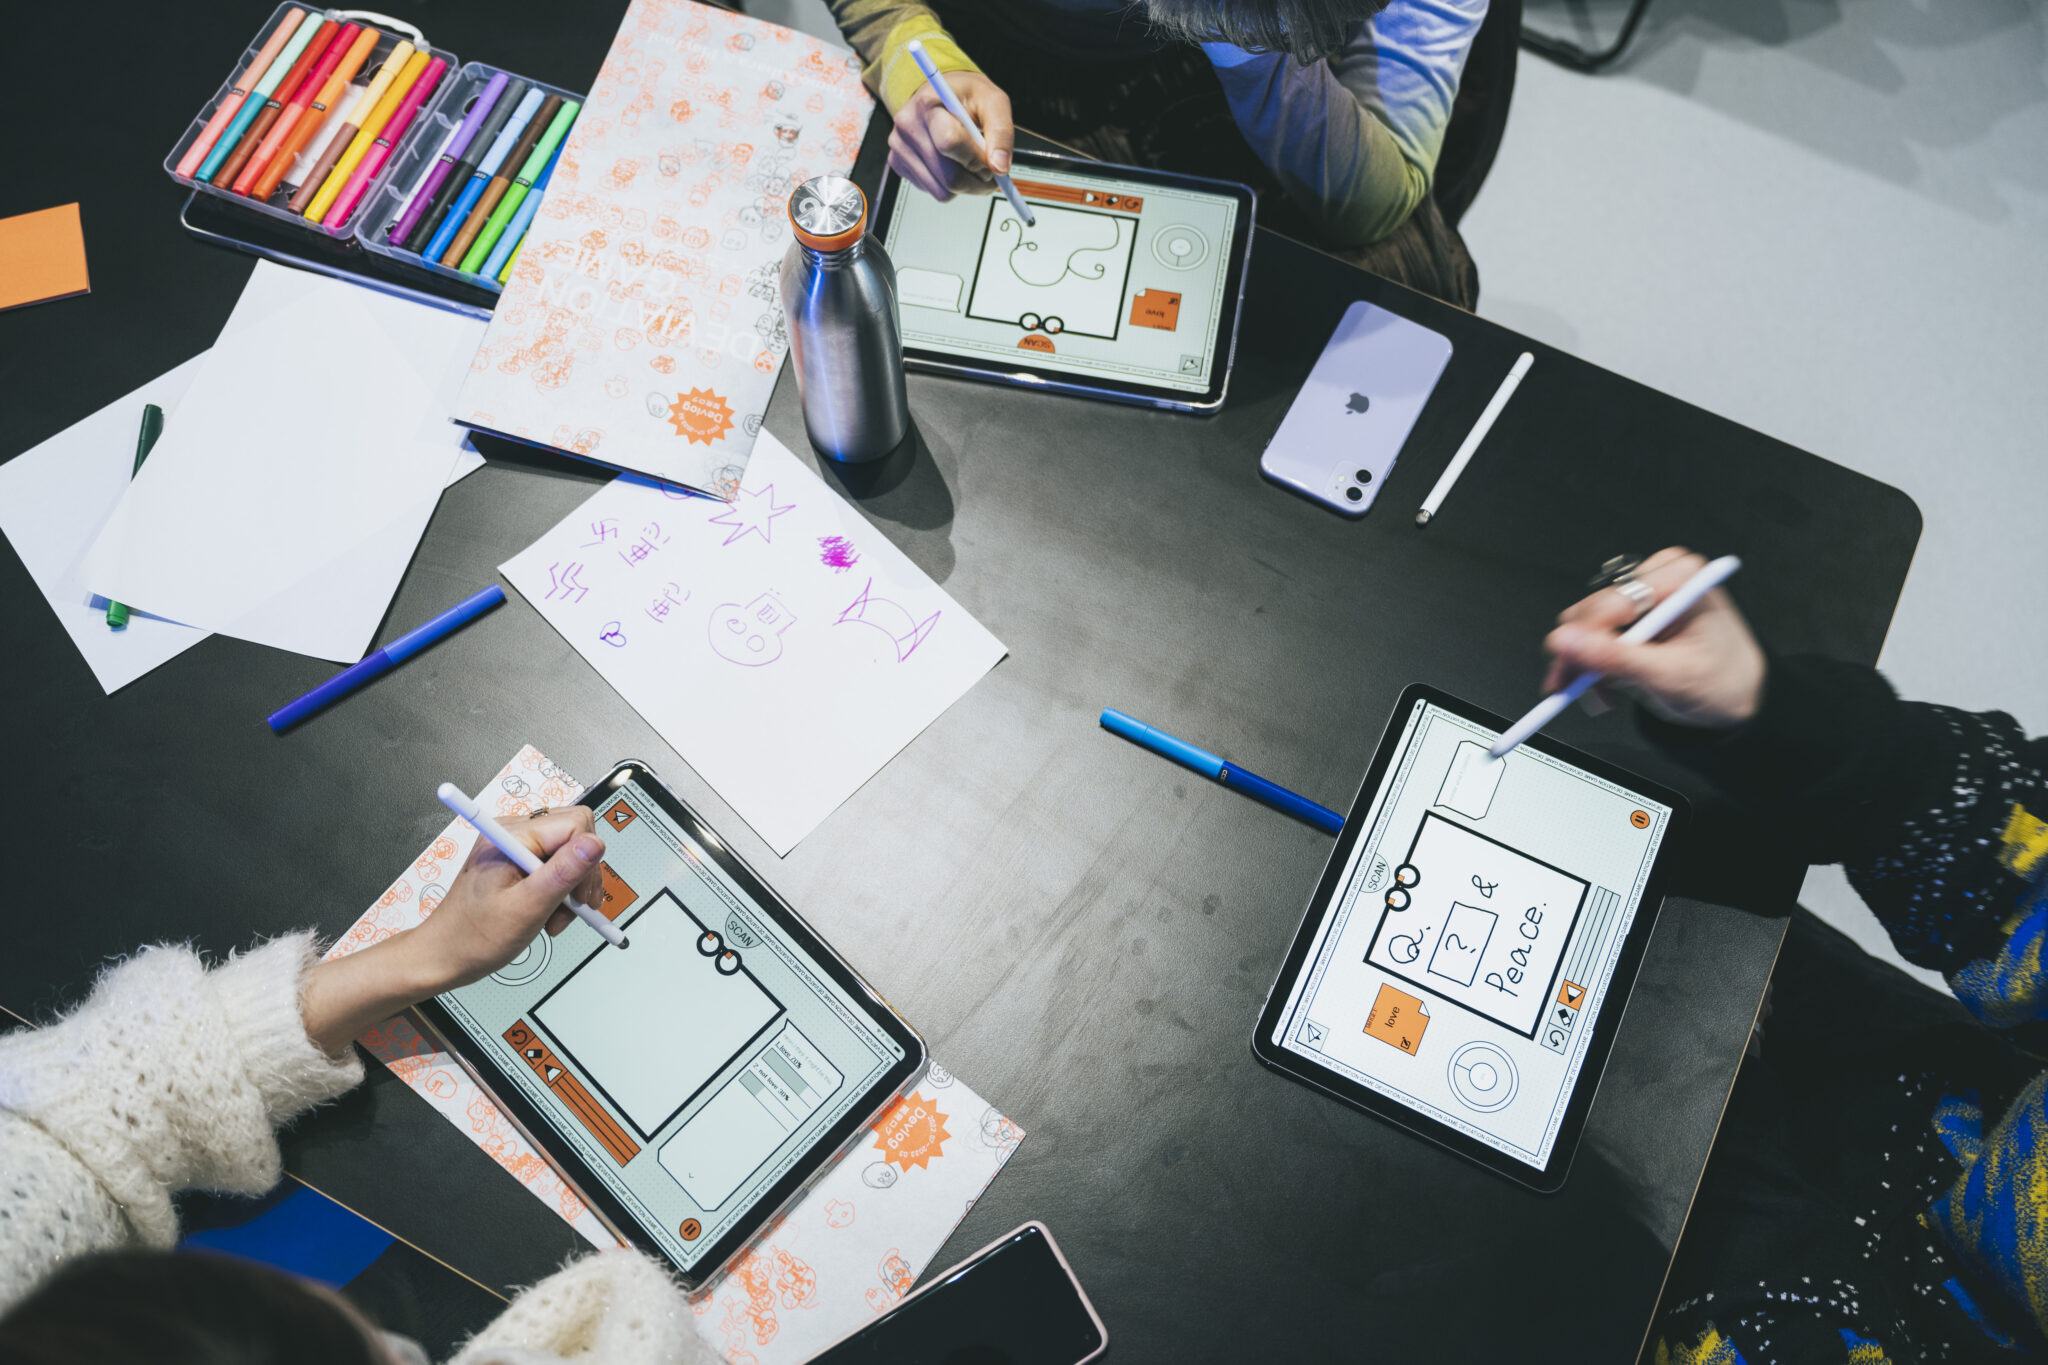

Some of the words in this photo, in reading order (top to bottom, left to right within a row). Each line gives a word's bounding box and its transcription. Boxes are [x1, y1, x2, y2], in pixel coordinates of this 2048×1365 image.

[683, 401, 723, 424] Devlog
[1368, 862, 1386, 890] SCAN
[1472, 874, 1498, 898] &
[728, 920, 753, 946] SCAN
[1385, 1006, 1400, 1028] love
[780, 1045, 791, 1058] love
[790, 1055, 802, 1069] 70%
[758, 1068, 768, 1078] not
[766, 1077, 779, 1089] love
[777, 1088, 790, 1100] 30%
[888, 1107, 926, 1149] Devlog
